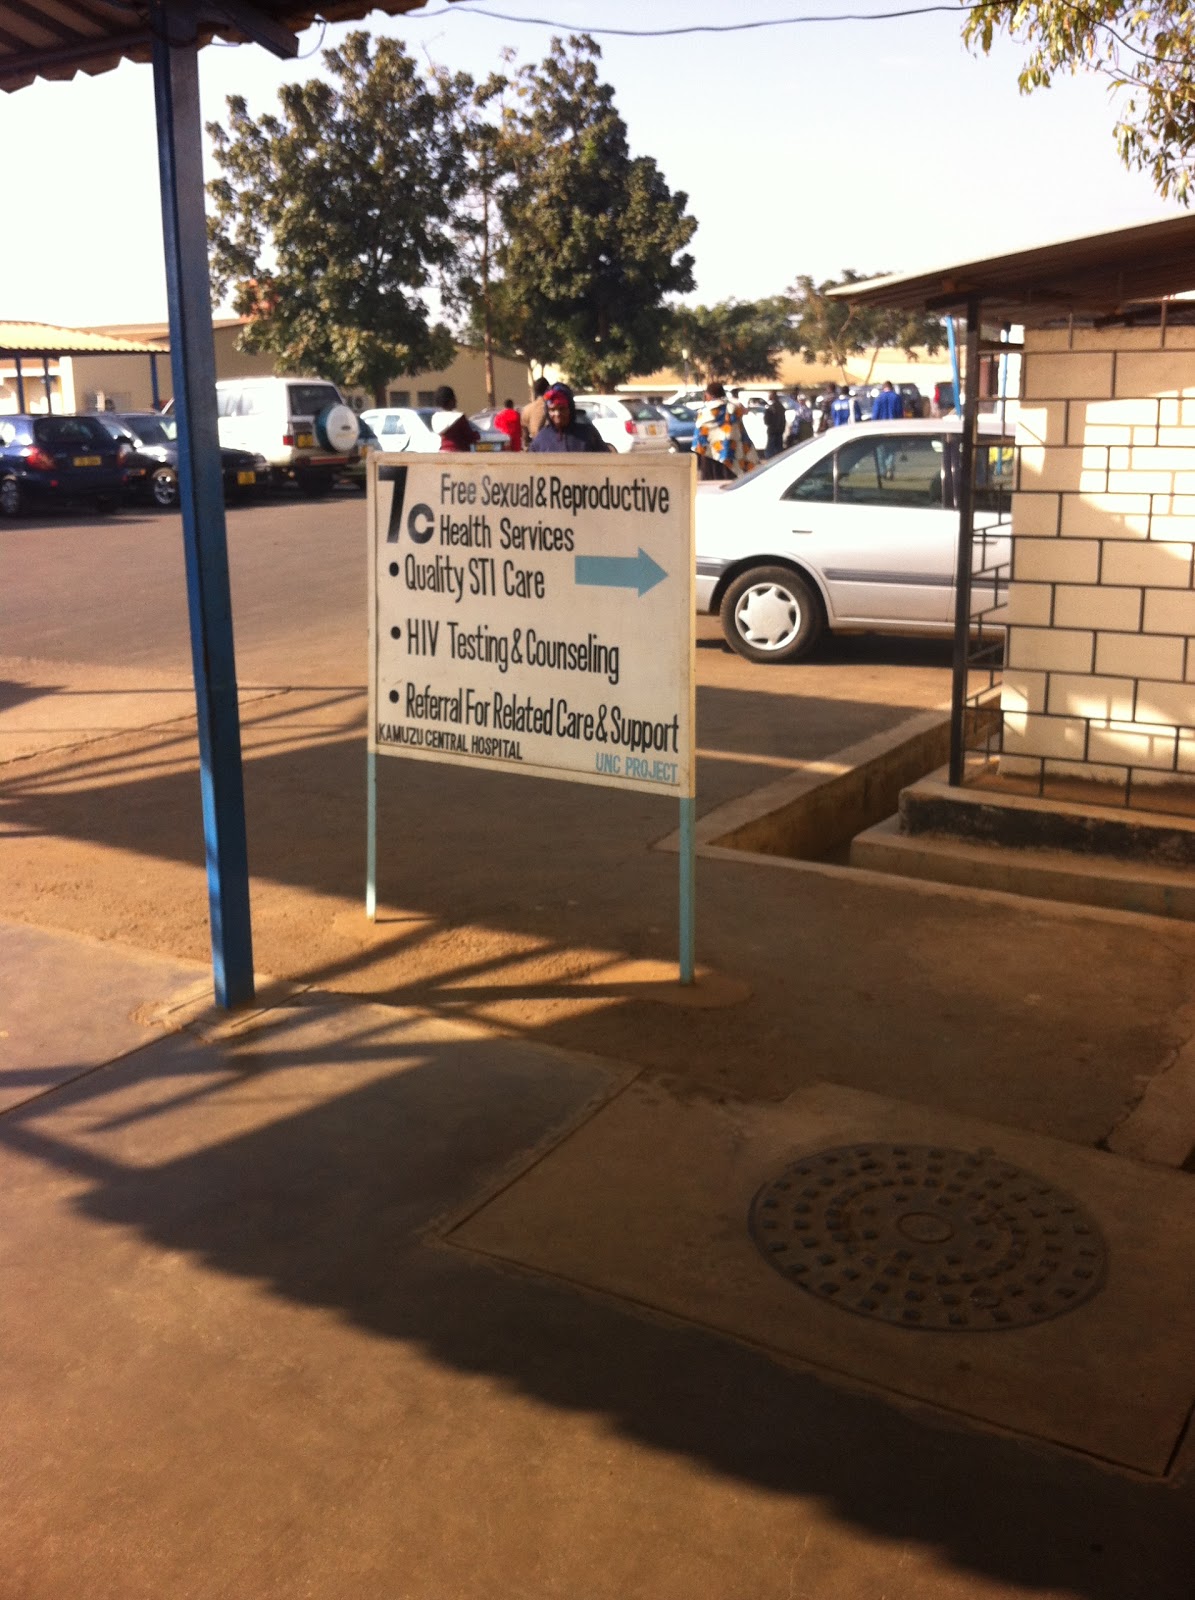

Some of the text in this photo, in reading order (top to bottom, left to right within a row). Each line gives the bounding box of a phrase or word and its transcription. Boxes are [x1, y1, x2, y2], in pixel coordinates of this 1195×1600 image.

[441, 473, 670, 516] Free Sexual & Reproductive
[440, 515, 574, 551] Health Services
[405, 554, 545, 603] Quality STI Care
[407, 618, 619, 685] HIV Testing & Counseling
[406, 682, 679, 754] Referral For Related Care & Support
[378, 723, 523, 760] KAMUZU CENTRAL HOSPITAL
[596, 753, 678, 783] UNC PROJECT
